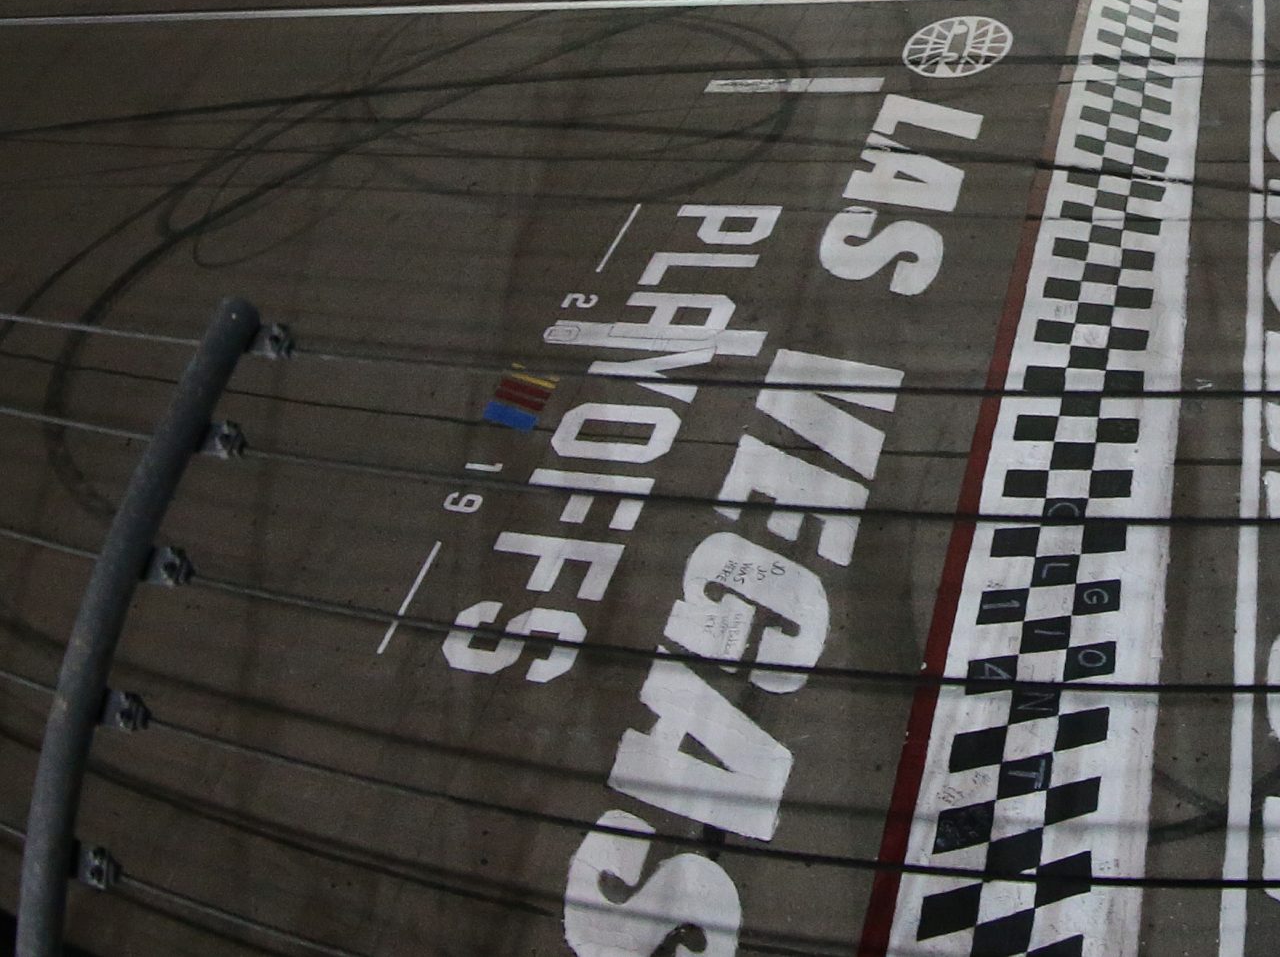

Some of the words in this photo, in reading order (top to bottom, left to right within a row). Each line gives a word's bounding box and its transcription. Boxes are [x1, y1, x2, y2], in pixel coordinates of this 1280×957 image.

[818, 93, 984, 296] LAS
[442, 204, 783, 684] PLAYOFFS
[563, 348, 906, 957] VEGAS
